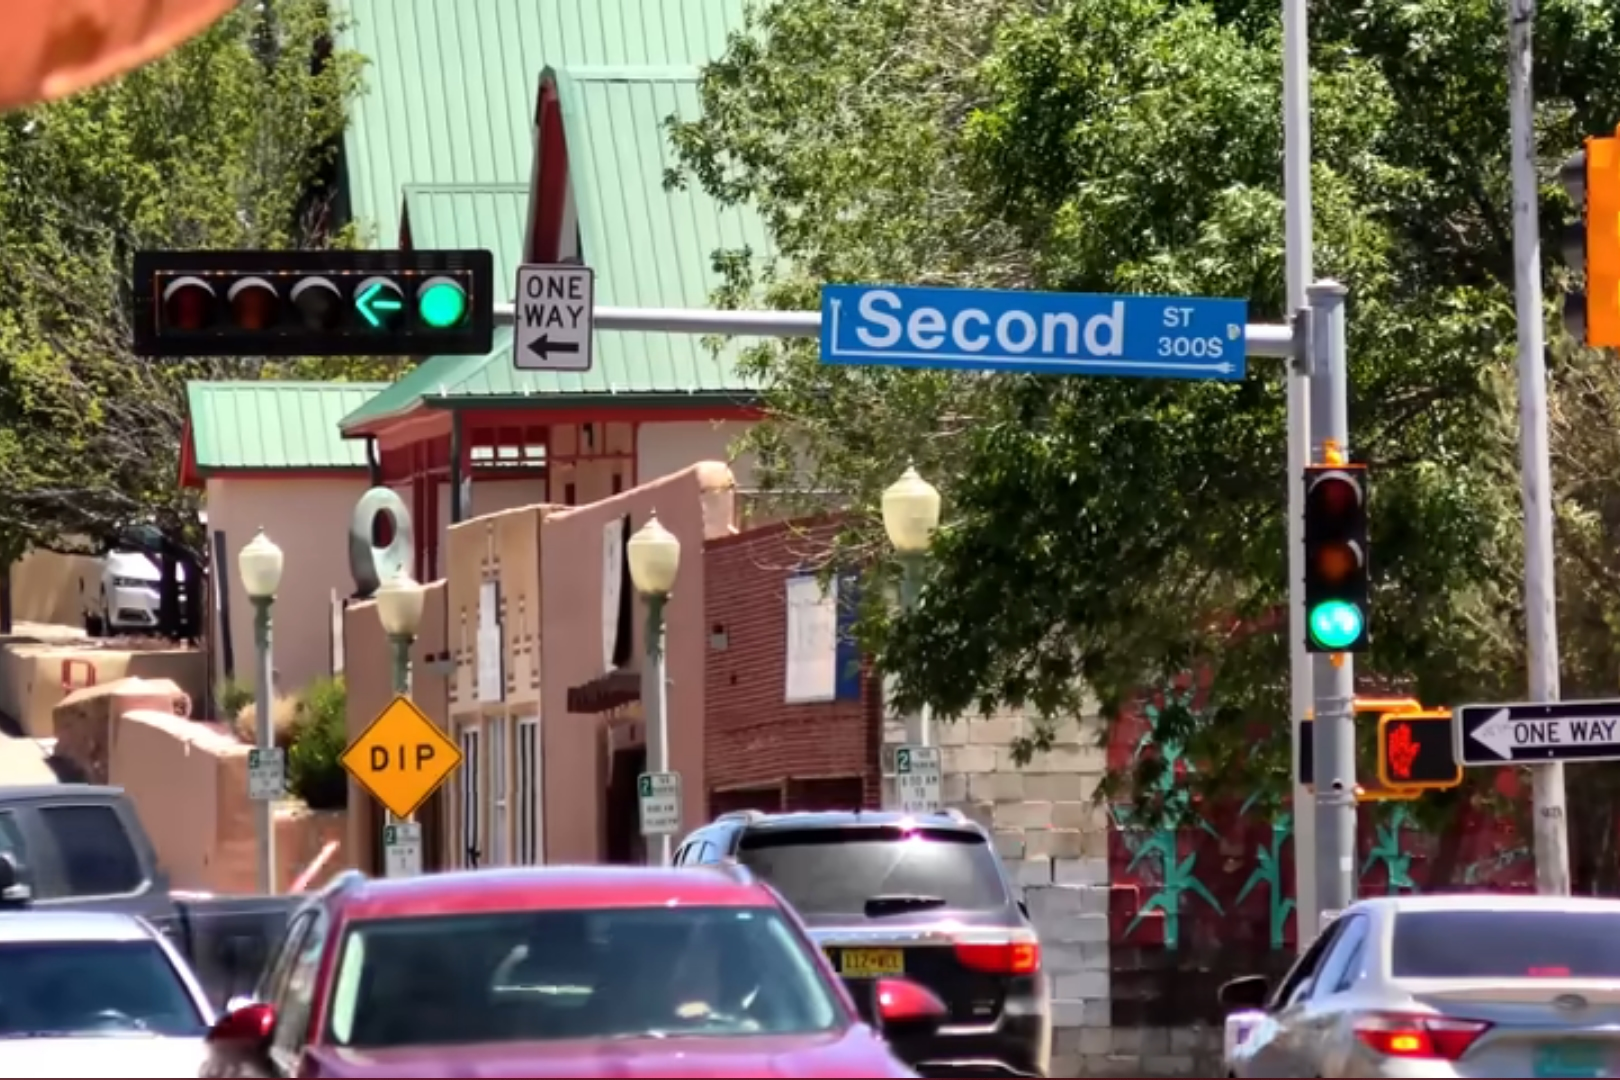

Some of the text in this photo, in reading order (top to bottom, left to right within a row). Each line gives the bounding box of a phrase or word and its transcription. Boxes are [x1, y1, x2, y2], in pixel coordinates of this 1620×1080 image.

[526, 274, 583, 300] ONE
[524, 303, 584, 329] WAY
[855, 290, 1125, 357] Second
[1162, 305, 1195, 328] ST
[1157, 336, 1224, 358] 300S
[1514, 719, 1617, 744] ONE WAY
[370, 743, 435, 772] DIP
